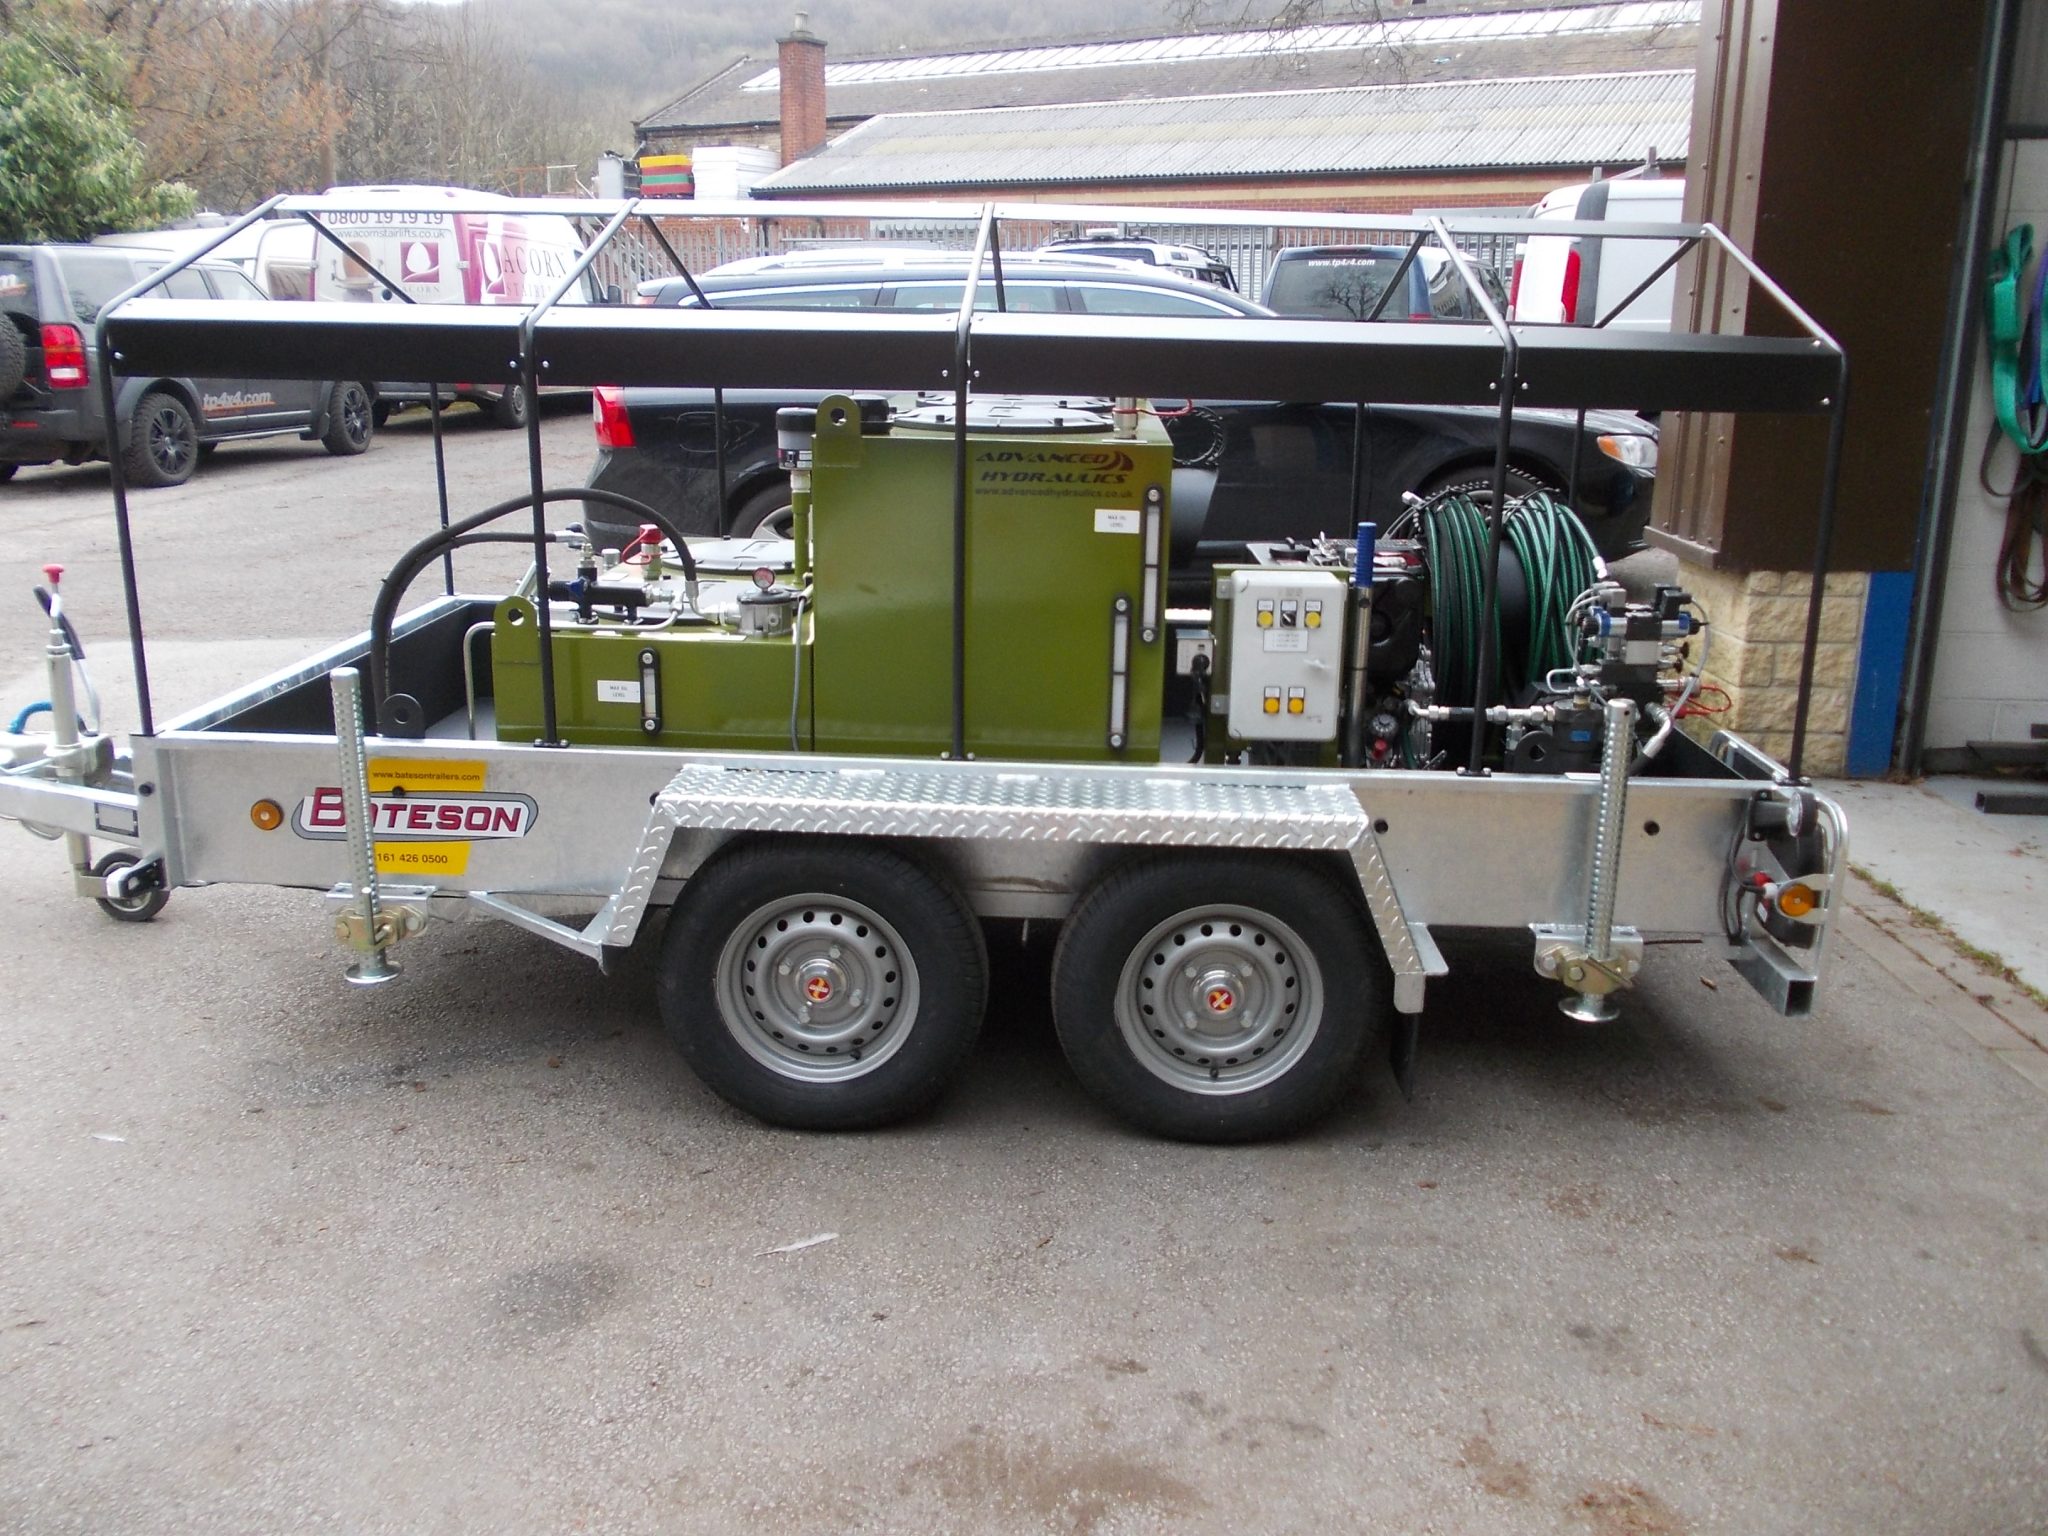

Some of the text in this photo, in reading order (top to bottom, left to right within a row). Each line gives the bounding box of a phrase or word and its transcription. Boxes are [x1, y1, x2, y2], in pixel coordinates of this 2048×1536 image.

[328, 211, 444, 225] 0800 19 19 19
[1308, 258, 1376, 267] www.tp4x4.com
[203, 390, 272, 411] tp4x4.com
[975, 451, 1110, 464] ADVANCED
[981, 470, 1129, 484] HYDRAULICS
[975, 487, 1133, 498] www.advancedhydraulics.co.uk
[372, 770, 481, 782] www.batesontrailers.com
[399, 853, 419, 863] 426
[421, 853, 449, 864] 0500
